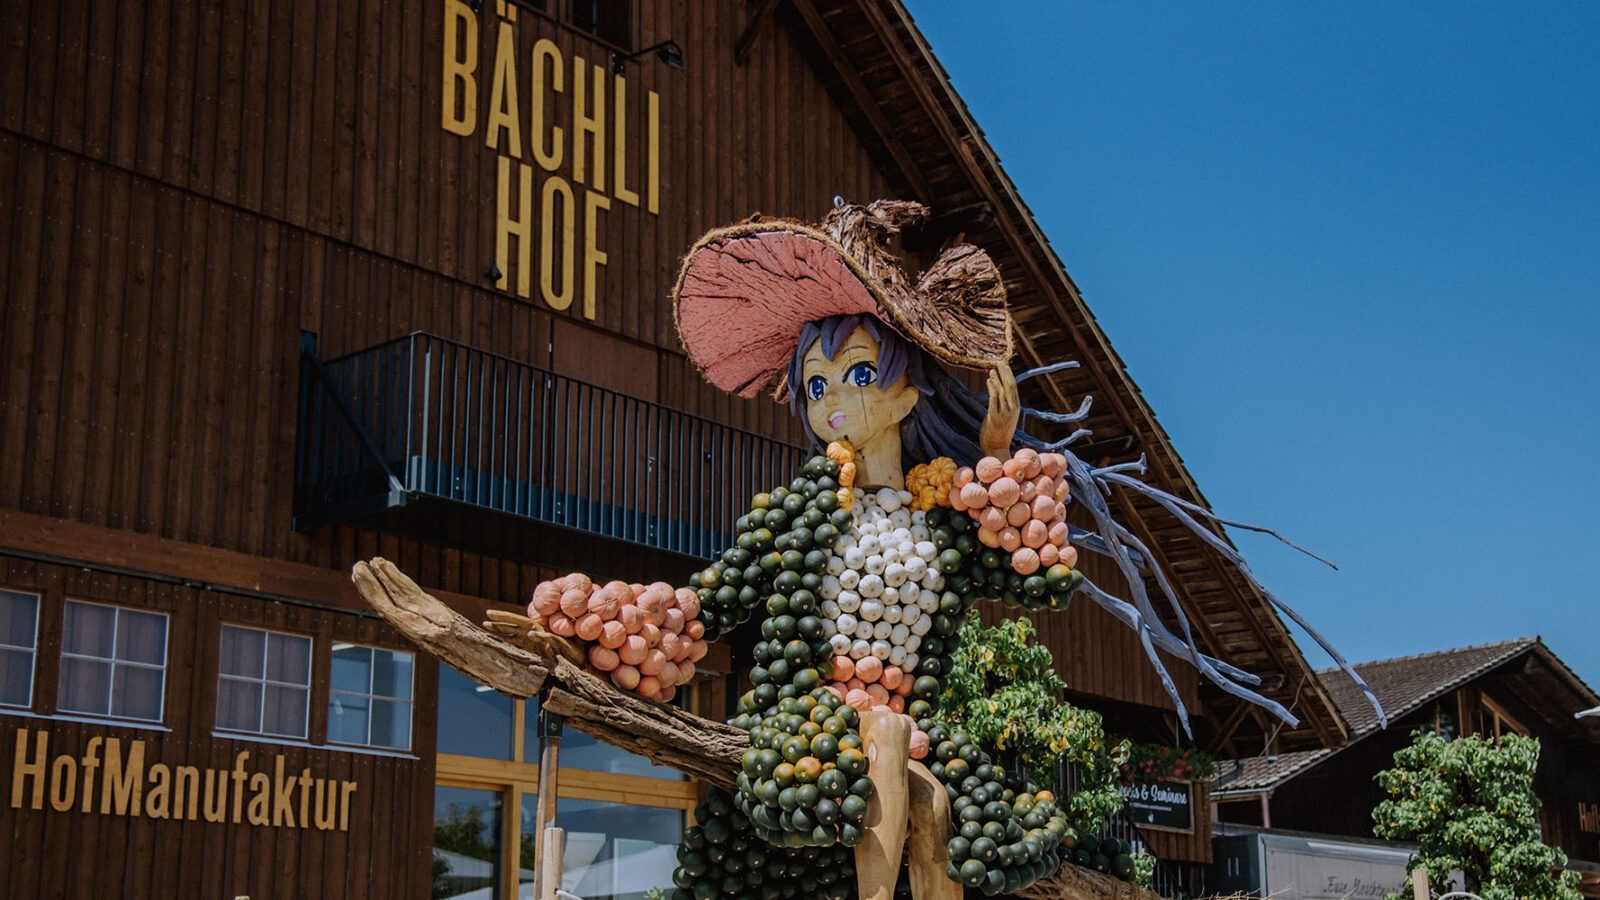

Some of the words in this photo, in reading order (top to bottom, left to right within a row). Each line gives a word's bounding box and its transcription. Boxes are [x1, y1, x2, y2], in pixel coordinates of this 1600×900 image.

[442, 0, 659, 215] BÄCHLI
[495, 155, 611, 321] HOF
[11, 728, 357, 831] HofManufaktur
[1141, 783, 1150, 801] &
[1150, 784, 1188, 805] Seminare
